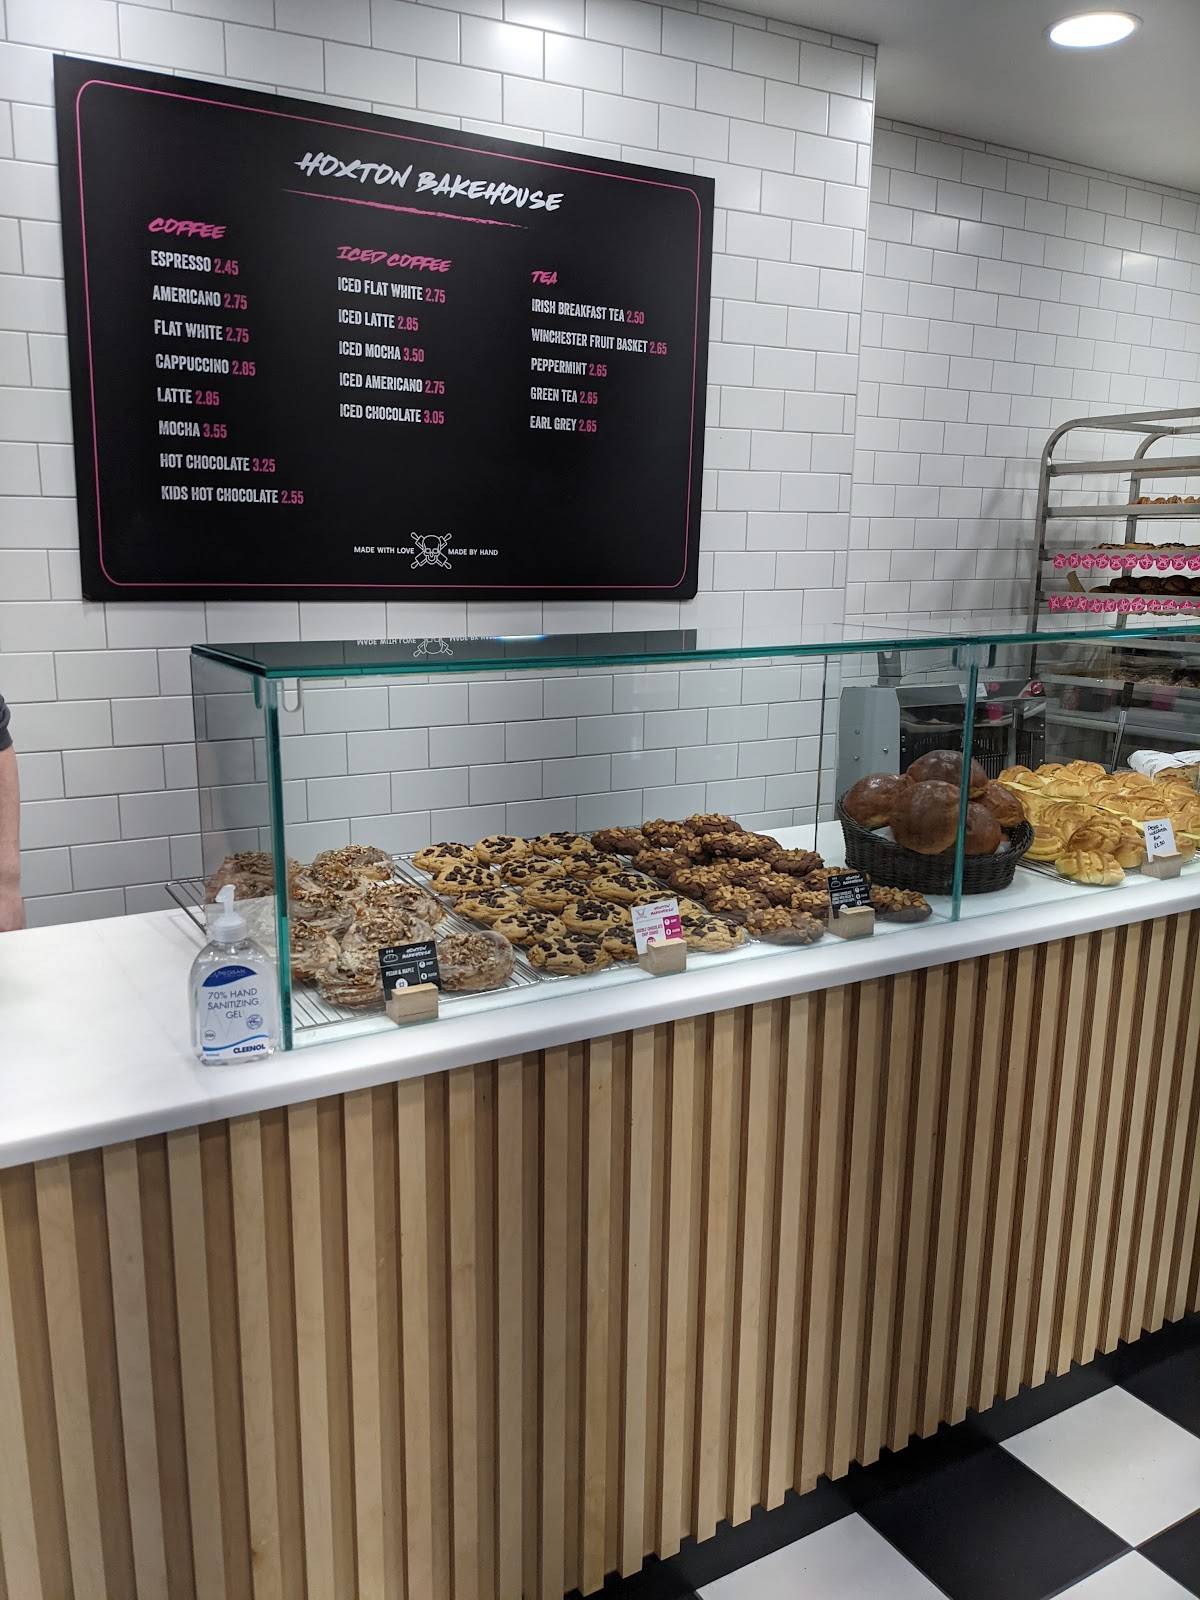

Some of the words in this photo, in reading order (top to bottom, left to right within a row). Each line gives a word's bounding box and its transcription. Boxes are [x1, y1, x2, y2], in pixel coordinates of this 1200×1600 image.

[294, 152, 413, 188] HOXTON
[415, 171, 564, 212] BAKEHOUSE
[147, 217, 225, 240] COFFEE
[151, 249, 212, 273] ESPRESSO
[213, 258, 240, 275] 2.45
[336, 245, 388, 264] ICED
[386, 253, 452, 273] COFFEE
[531, 269, 558, 286] TEA
[152, 285, 222, 307] AMERICANO
[223, 293, 248, 310] 2.75
[338, 276, 362, 294] ICED
[364, 279, 389, 297] FLAT
[390, 283, 424, 301] WHITE
[425, 287, 446, 303] 2.75
[338, 308, 363, 325] ICED
[364, 312, 396, 329] LATTE
[397, 315, 420, 332] 2.85
[531, 298, 557, 314] IRISH
[558, 301, 607, 320] BREAKFAST
[608, 307, 625, 323] TEA
[626, 309, 645, 325] 2.50
[154, 319, 183, 337] FLAT
[184, 322, 224, 341] WHITE
[225, 326, 250, 343] 2.75
[531, 328, 588, 347] WINCHESTER
[589, 334, 615, 350] FRUIT
[616, 337, 649, 353] BASKET
[649, 341, 668, 355] 2.65
[339, 340, 363, 357] ICED
[364, 343, 402, 361] MOCHA
[403, 347, 425, 363] 3.50
[155, 353, 230, 375] CAPPUCCINO
[231, 360, 257, 377] 2.85
[530, 357, 588, 376] PEPPERMINT
[588, 363, 608, 378] 2.65
[340, 372, 363, 388] ICED
[364, 375, 423, 393] AMERICANO
[424, 380, 446, 395] 2.75
[157, 386, 193, 405] LATTE
[194, 389, 220, 406] 2.85
[530, 386, 560, 402] GREEN
[560, 389, 578, 404] TEA
[340, 403, 364, 419] ICED
[365, 406, 422, 423] CHOCOLATE
[423, 409, 445, 425] 3.05
[529, 415, 553, 430] EARL
[553, 417, 578, 432] GREY
[578, 419, 597, 433] 2.65
[159, 419, 201, 437] MOCHA
[202, 423, 228, 439] 3.55
[160, 452, 184, 469] HOT
[185, 455, 251, 472] CHOCOLATE
[252, 458, 276, 473] 3.25
[161, 485, 189, 501] KIDS
[190, 486, 214, 502] HOT
[215, 487, 279, 504] CHOCOLATE
[280, 490, 305, 505] 2.55
[353, 545, 375, 554] MADE
[376, 546, 396, 555] WITH
[396, 546, 415, 555] LOVE
[447, 548, 468, 556] MADE
[468, 548, 478, 556] BY
[479, 548, 499, 556] HAND
[208, 991, 228, 1000] 70%
[230, 987, 258, 998] HAND
[207, 998, 259, 1011] SANITIZING
[225, 1010, 243, 1020] GEL
[233, 1043, 266, 1055] CLEENOL
